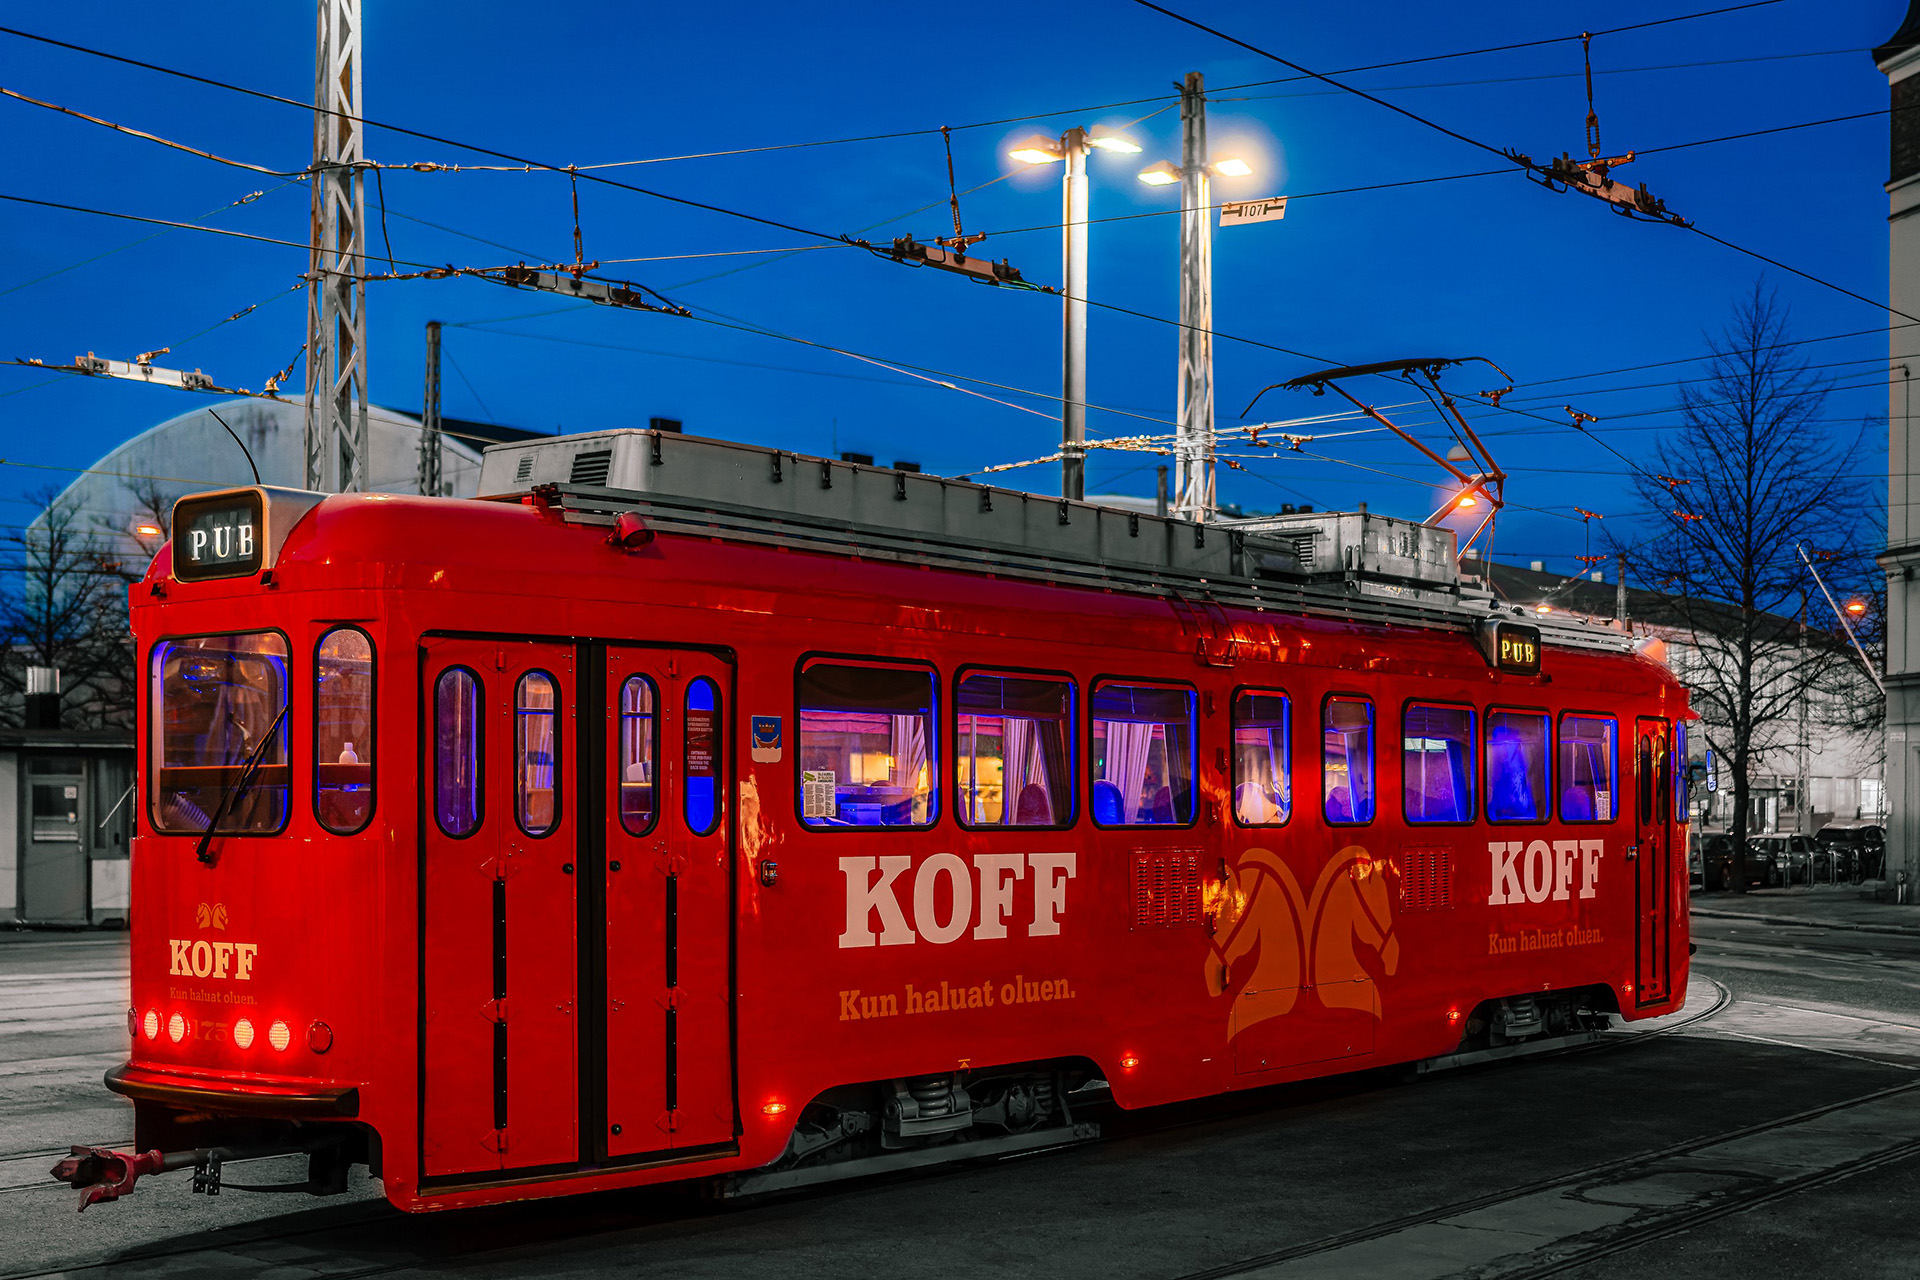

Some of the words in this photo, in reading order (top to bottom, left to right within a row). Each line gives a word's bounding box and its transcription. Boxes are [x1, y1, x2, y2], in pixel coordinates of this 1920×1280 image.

[1244, 204, 1262, 217] 107
[191, 524, 253, 561] PUB
[1502, 640, 1535, 663] PUB
[1488, 839, 1604, 905] KOFF
[839, 852, 1077, 949] KOFF
[1488, 933, 1517, 955] Kun
[1520, 929, 1563, 952] haluat
[1566, 925, 1604, 947] oluen.
[169, 939, 258, 980] KOFF
[170, 987, 188, 1000] Kun
[190, 988, 221, 1003] haluat
[223, 991, 258, 1005] oluen.
[839, 989, 898, 1021] Kun
[905, 980, 995, 1015] haluat
[1000, 974, 1076, 1005] oluen.
